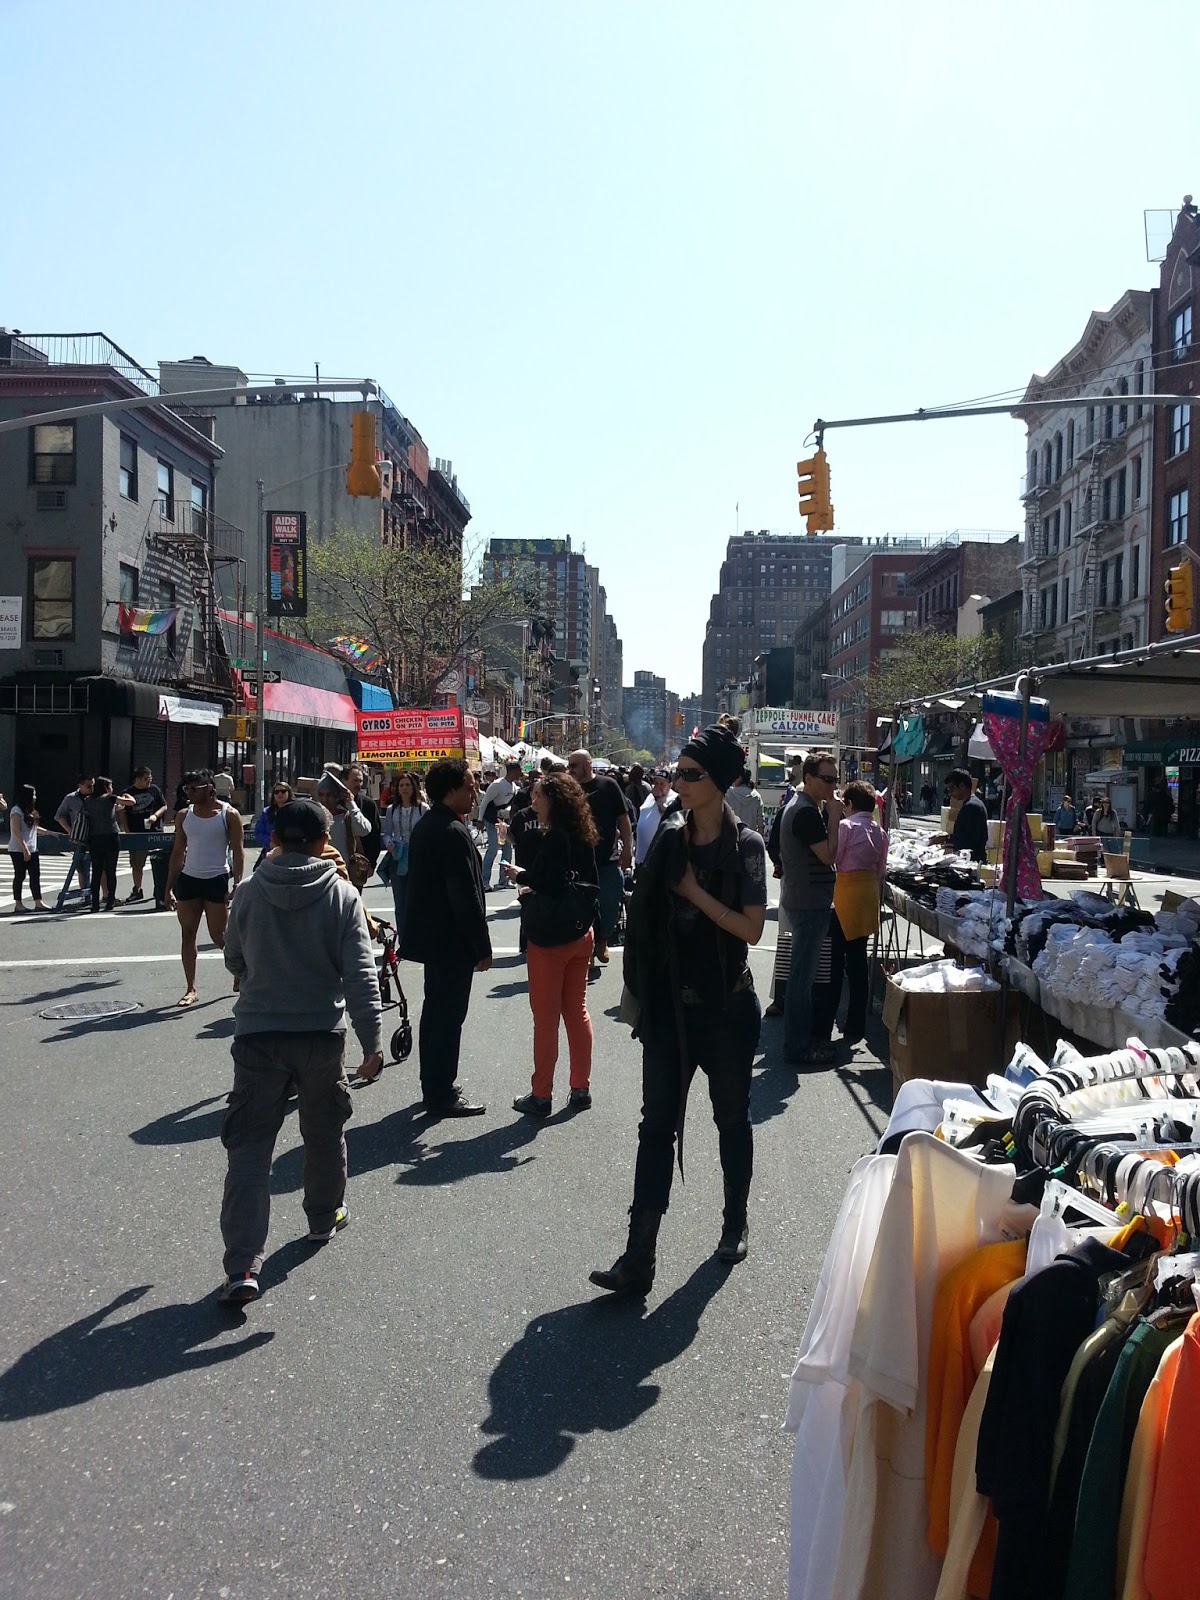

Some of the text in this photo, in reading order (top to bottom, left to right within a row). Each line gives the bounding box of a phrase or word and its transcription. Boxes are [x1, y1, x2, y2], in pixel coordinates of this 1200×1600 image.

[275, 516, 297, 526] AIDS
[270, 544, 282, 600] COMMUNITY
[296, 550, 304, 598] aidswalk.net
[0, 614, 18, 622] EASE
[756, 711, 785, 723] ZEPPOLE
[791, 712, 814, 722] FUNNEL
[818, 714, 836, 726] CAKE
[362, 719, 390, 730] GYROS
[772, 722, 820, 732] CALZONE
[362, 738, 416, 747] FRENCH
[421, 737, 460, 745] FRIES
[1180, 748, 1200, 762] PIZZ
